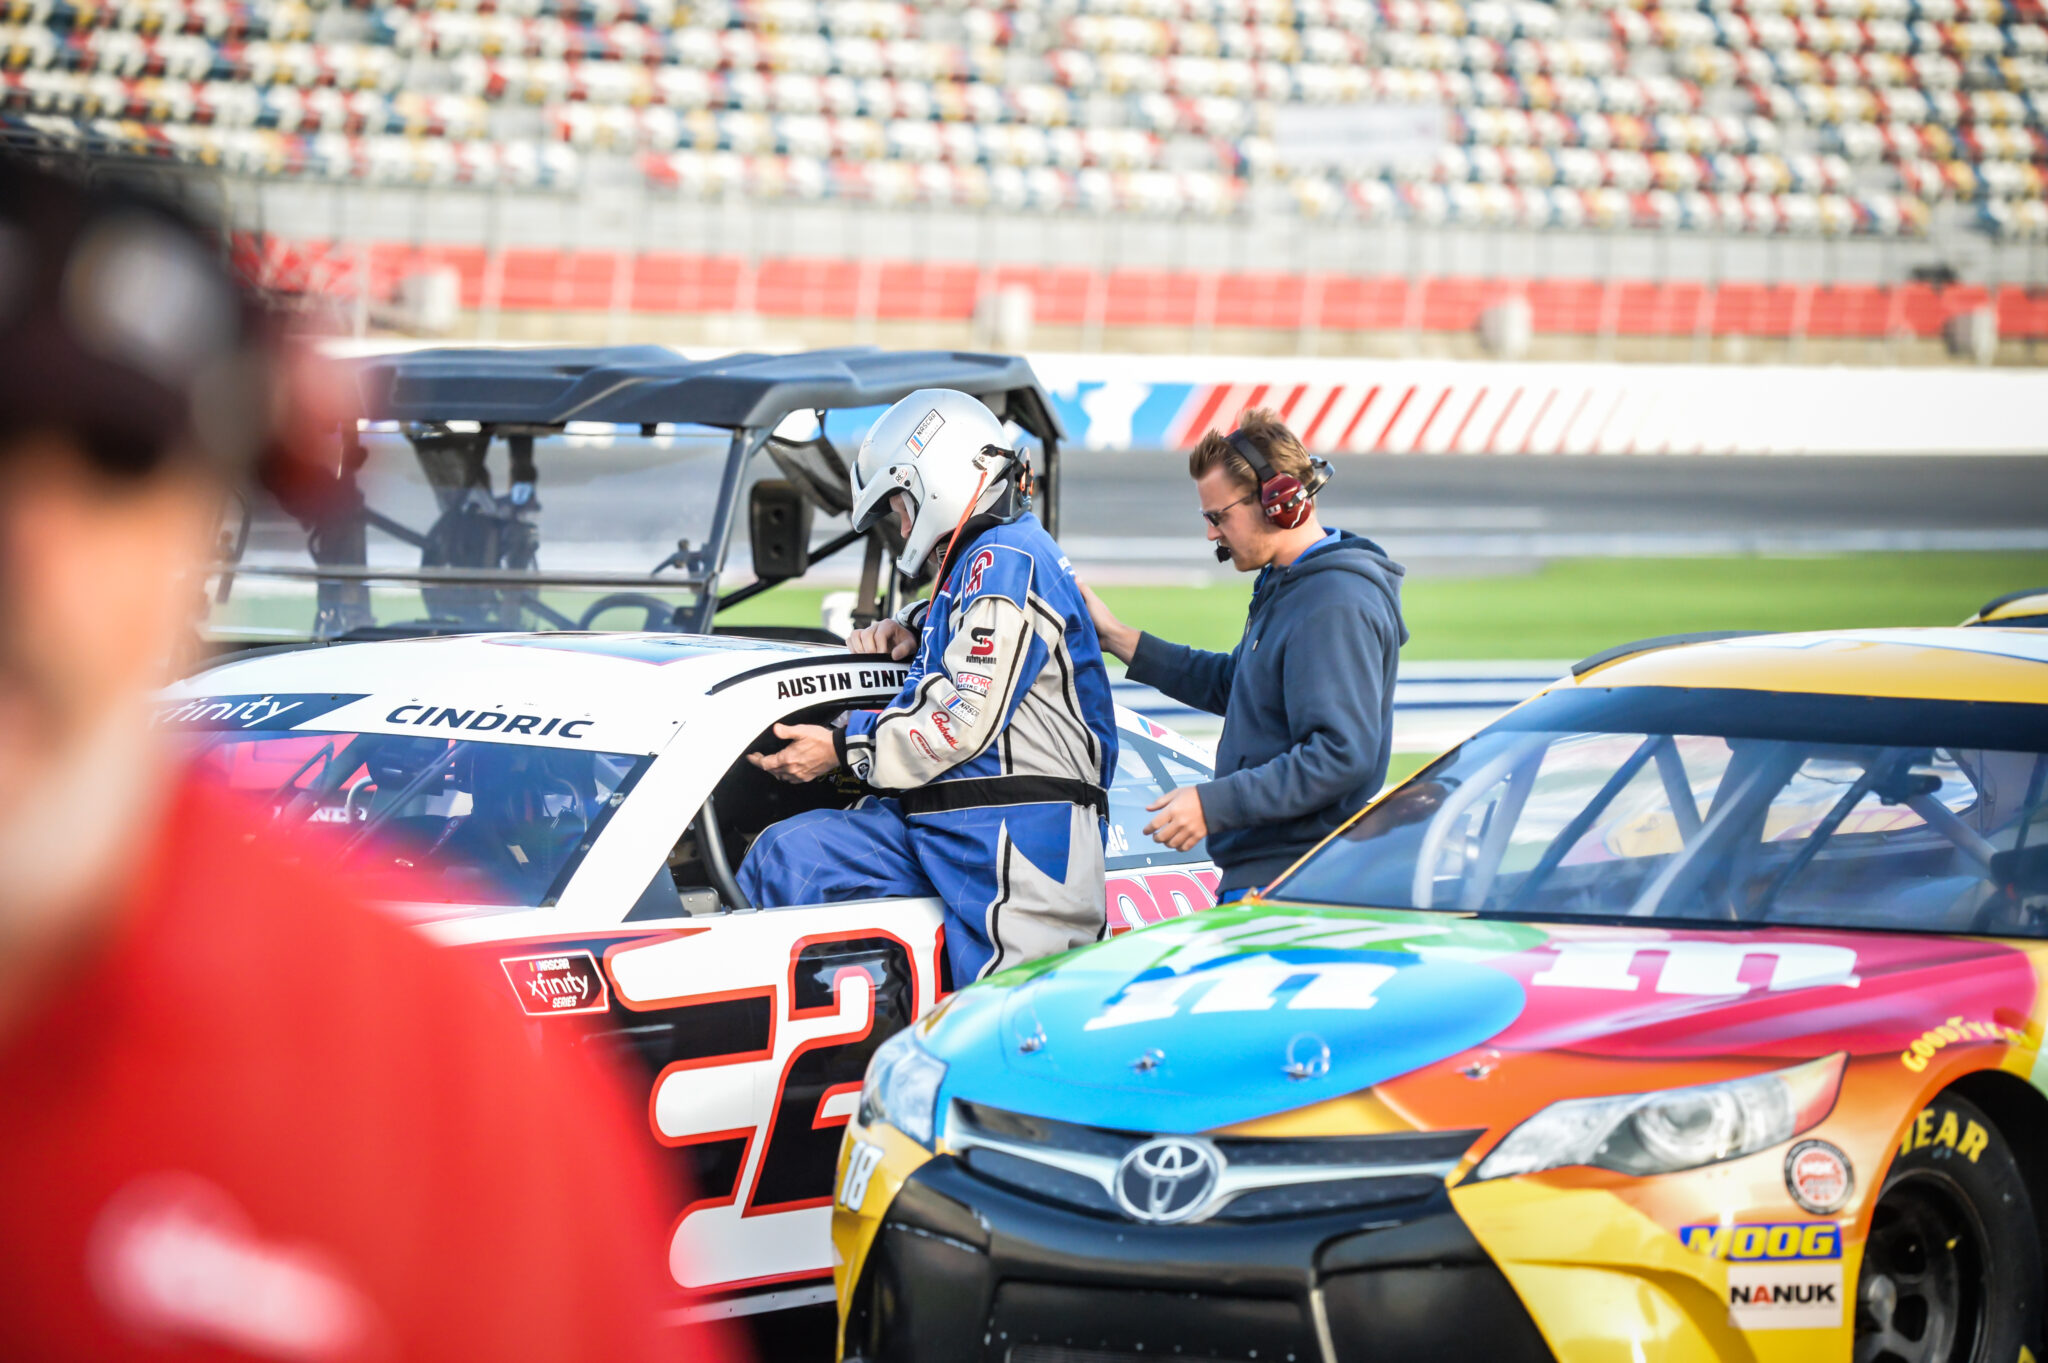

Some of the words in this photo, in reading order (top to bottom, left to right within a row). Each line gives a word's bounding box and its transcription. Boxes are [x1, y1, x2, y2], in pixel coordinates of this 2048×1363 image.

[917, 413, 937, 437] NASCAR
[777, 672, 852, 700] AUSTIN
[385, 704, 597, 739] CINDRIC
[538, 958, 571, 972] NASCAR
[526, 972, 589, 1003] xfinity
[552, 996, 578, 1008] SERIES
[840, 1140, 884, 1213] 18
[1688, 1225, 1836, 1259] MOOG
[1731, 1284, 1836, 1304] NANUK
